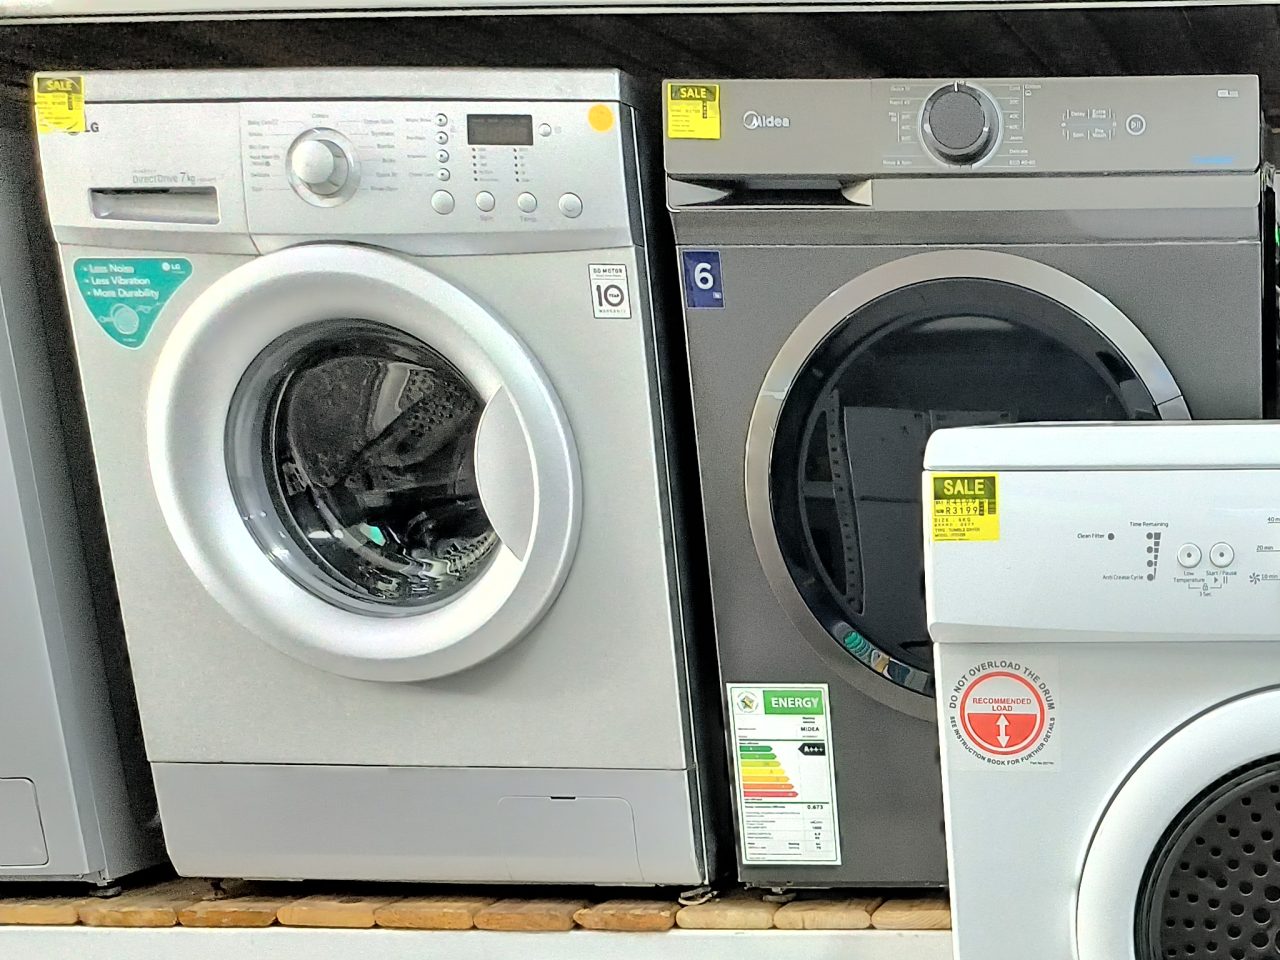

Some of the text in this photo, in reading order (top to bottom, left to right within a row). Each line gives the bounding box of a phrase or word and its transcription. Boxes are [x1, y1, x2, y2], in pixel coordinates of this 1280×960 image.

[47, 80, 72, 91] SALE
[680, 87, 707, 98] SALE
[744, 113, 790, 128] Midea
[109, 264, 135, 274] Noise
[91, 276, 151, 286] Less Vibration
[694, 262, 714, 290] 6
[93, 288, 160, 300] More Durability
[596, 284, 625, 307] 10
[943, 479, 985, 495] SALE
[945, 506, 978, 514] R3199
[949, 660, 1055, 710] DO NOT OVERLOAD THE DRUM
[771, 697, 819, 709] ENERGY
[972, 697, 1032, 705] RECOMMENDED
[950, 716, 1056, 766] SEE INSTRUCTION BOOK FOR FURTHER DETAILS
[804, 745, 824, 753] A+++
